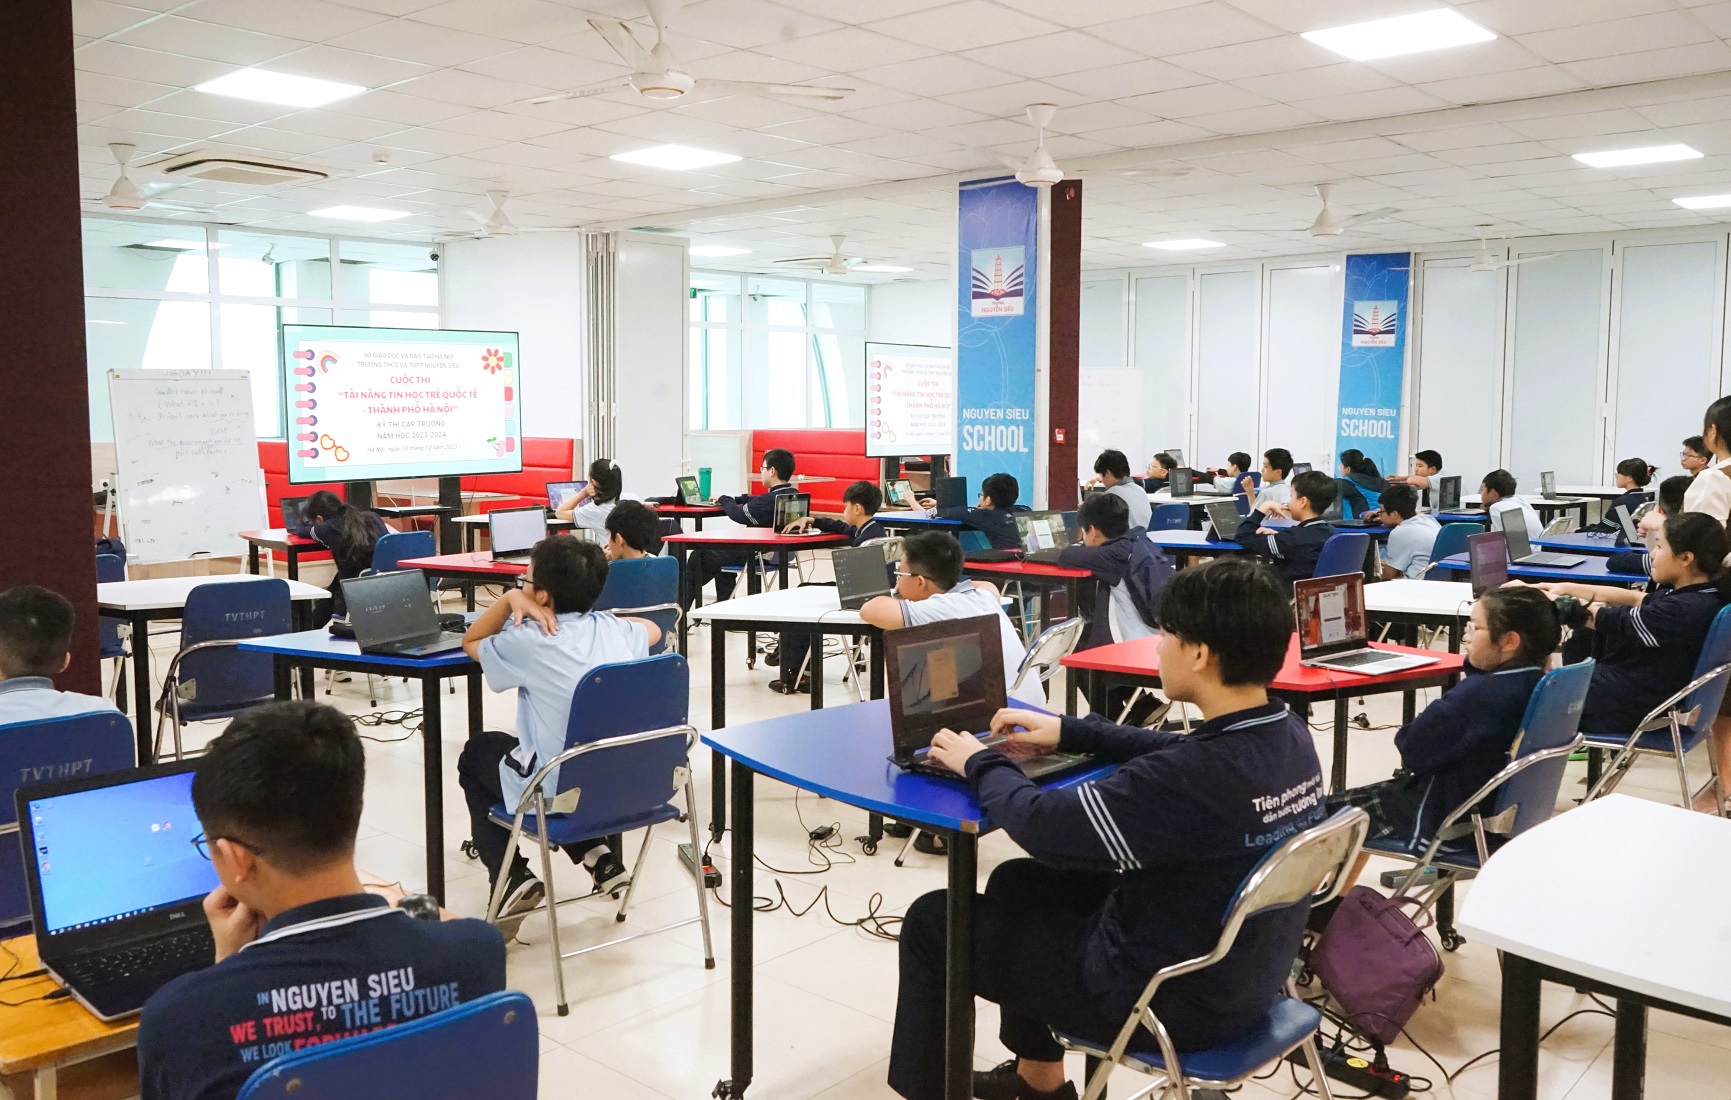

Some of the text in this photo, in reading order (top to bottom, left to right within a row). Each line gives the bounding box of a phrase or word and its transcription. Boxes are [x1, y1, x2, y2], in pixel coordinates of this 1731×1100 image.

[390, 373, 430, 387] CUỘC THI
[360, 388, 387, 399] NĂNG
[388, 391, 403, 399] TIN
[405, 391, 424, 402] HỌC
[368, 402, 400, 414] THÀNH
[423, 402, 436, 413] HÀ
[962, 408, 1029, 420] NGUYEN SIEU
[1342, 408, 1396, 416] NGUYEN SIEU
[412, 430, 446, 439] 2023-2024
[1341, 419, 1394, 438] SCHOOL
[963, 425, 1028, 452] SCHOOL
[1244, 821, 1298, 848] Leading
[256, 966, 415, 1013] IN NGUYEN SIEU
[320, 982, 460, 1029] TO THE FUTURE
[230, 1020, 257, 1044] WE
[263, 1010, 321, 1038] TRUST,
[240, 1040, 292, 1064] WE LOOK
